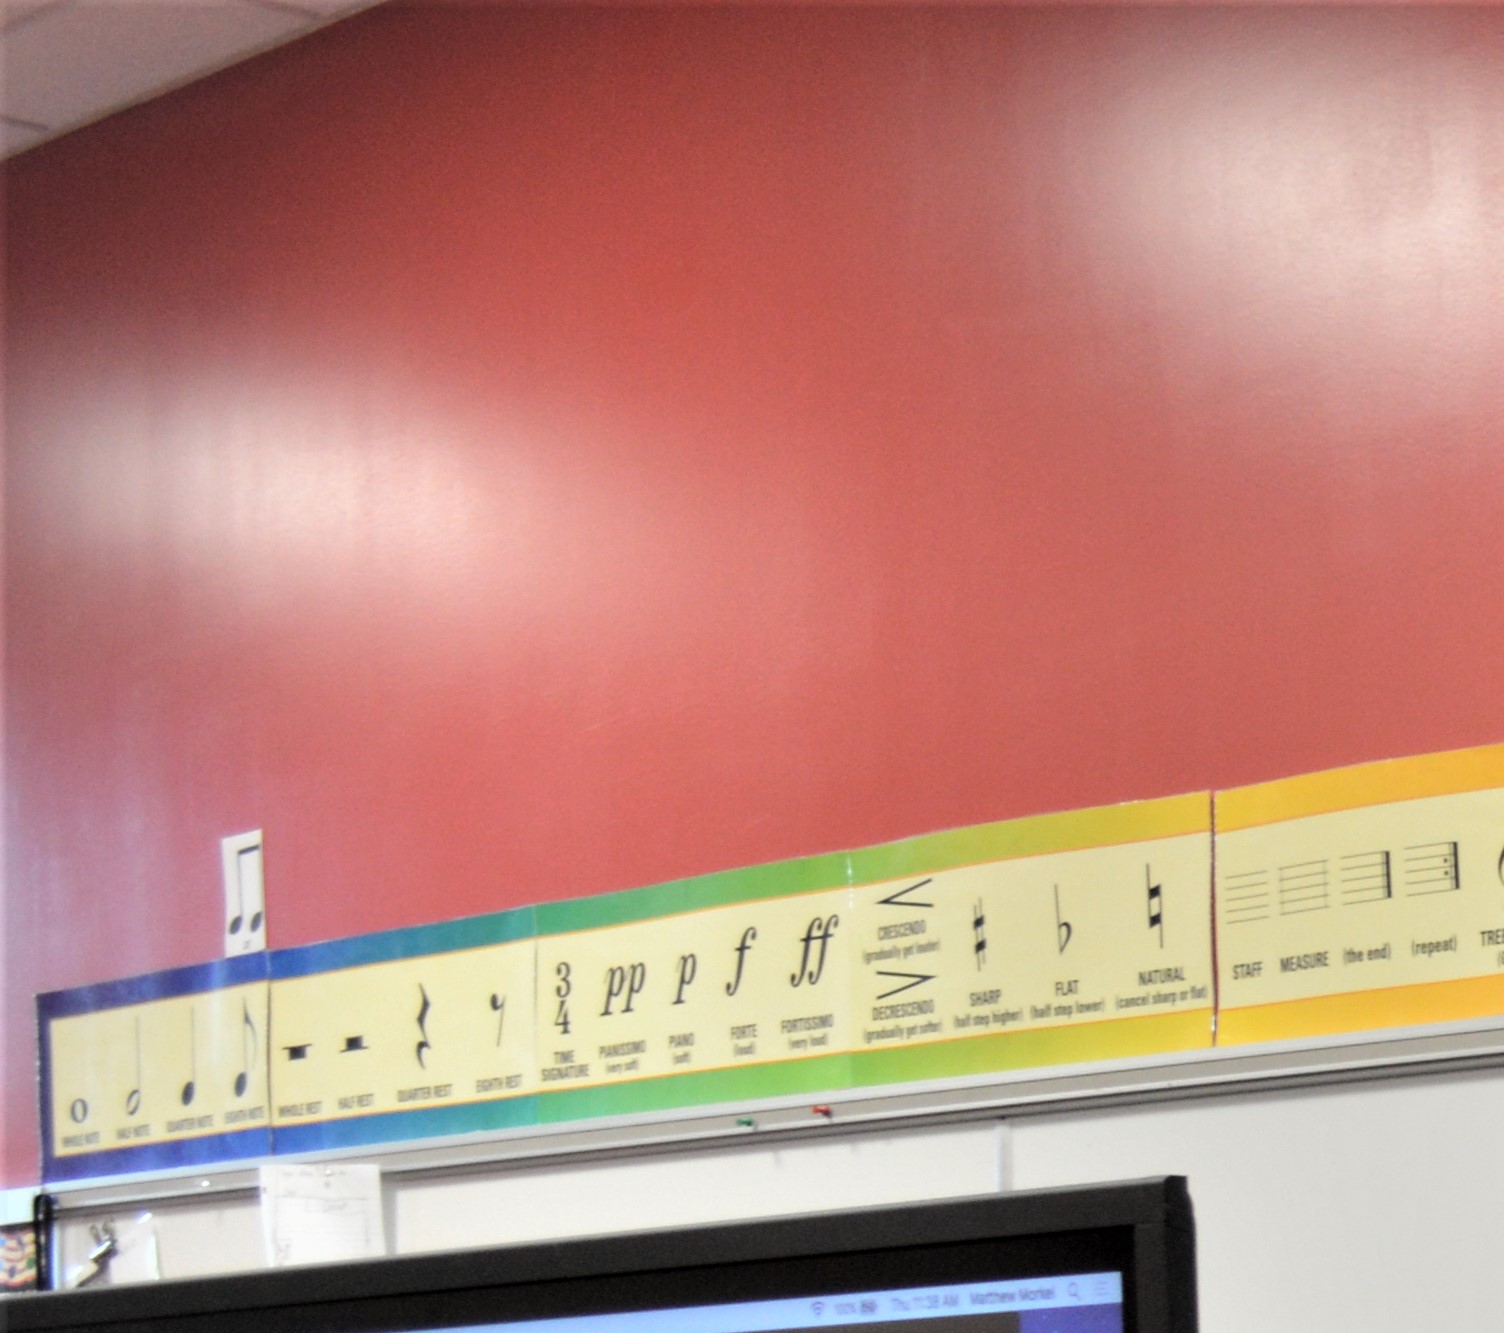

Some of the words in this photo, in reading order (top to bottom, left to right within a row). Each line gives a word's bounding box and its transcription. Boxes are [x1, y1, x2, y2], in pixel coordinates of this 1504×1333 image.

[1232, 960, 1263, 981] STAFF
[1280, 950, 1329, 973] MEASURE
[1137, 966, 1186, 986] NATURAL
[969, 988, 1002, 1008] SHARP
[1055, 979, 1079, 997] FLAT
[730, 1023, 758, 1041] FORTE
